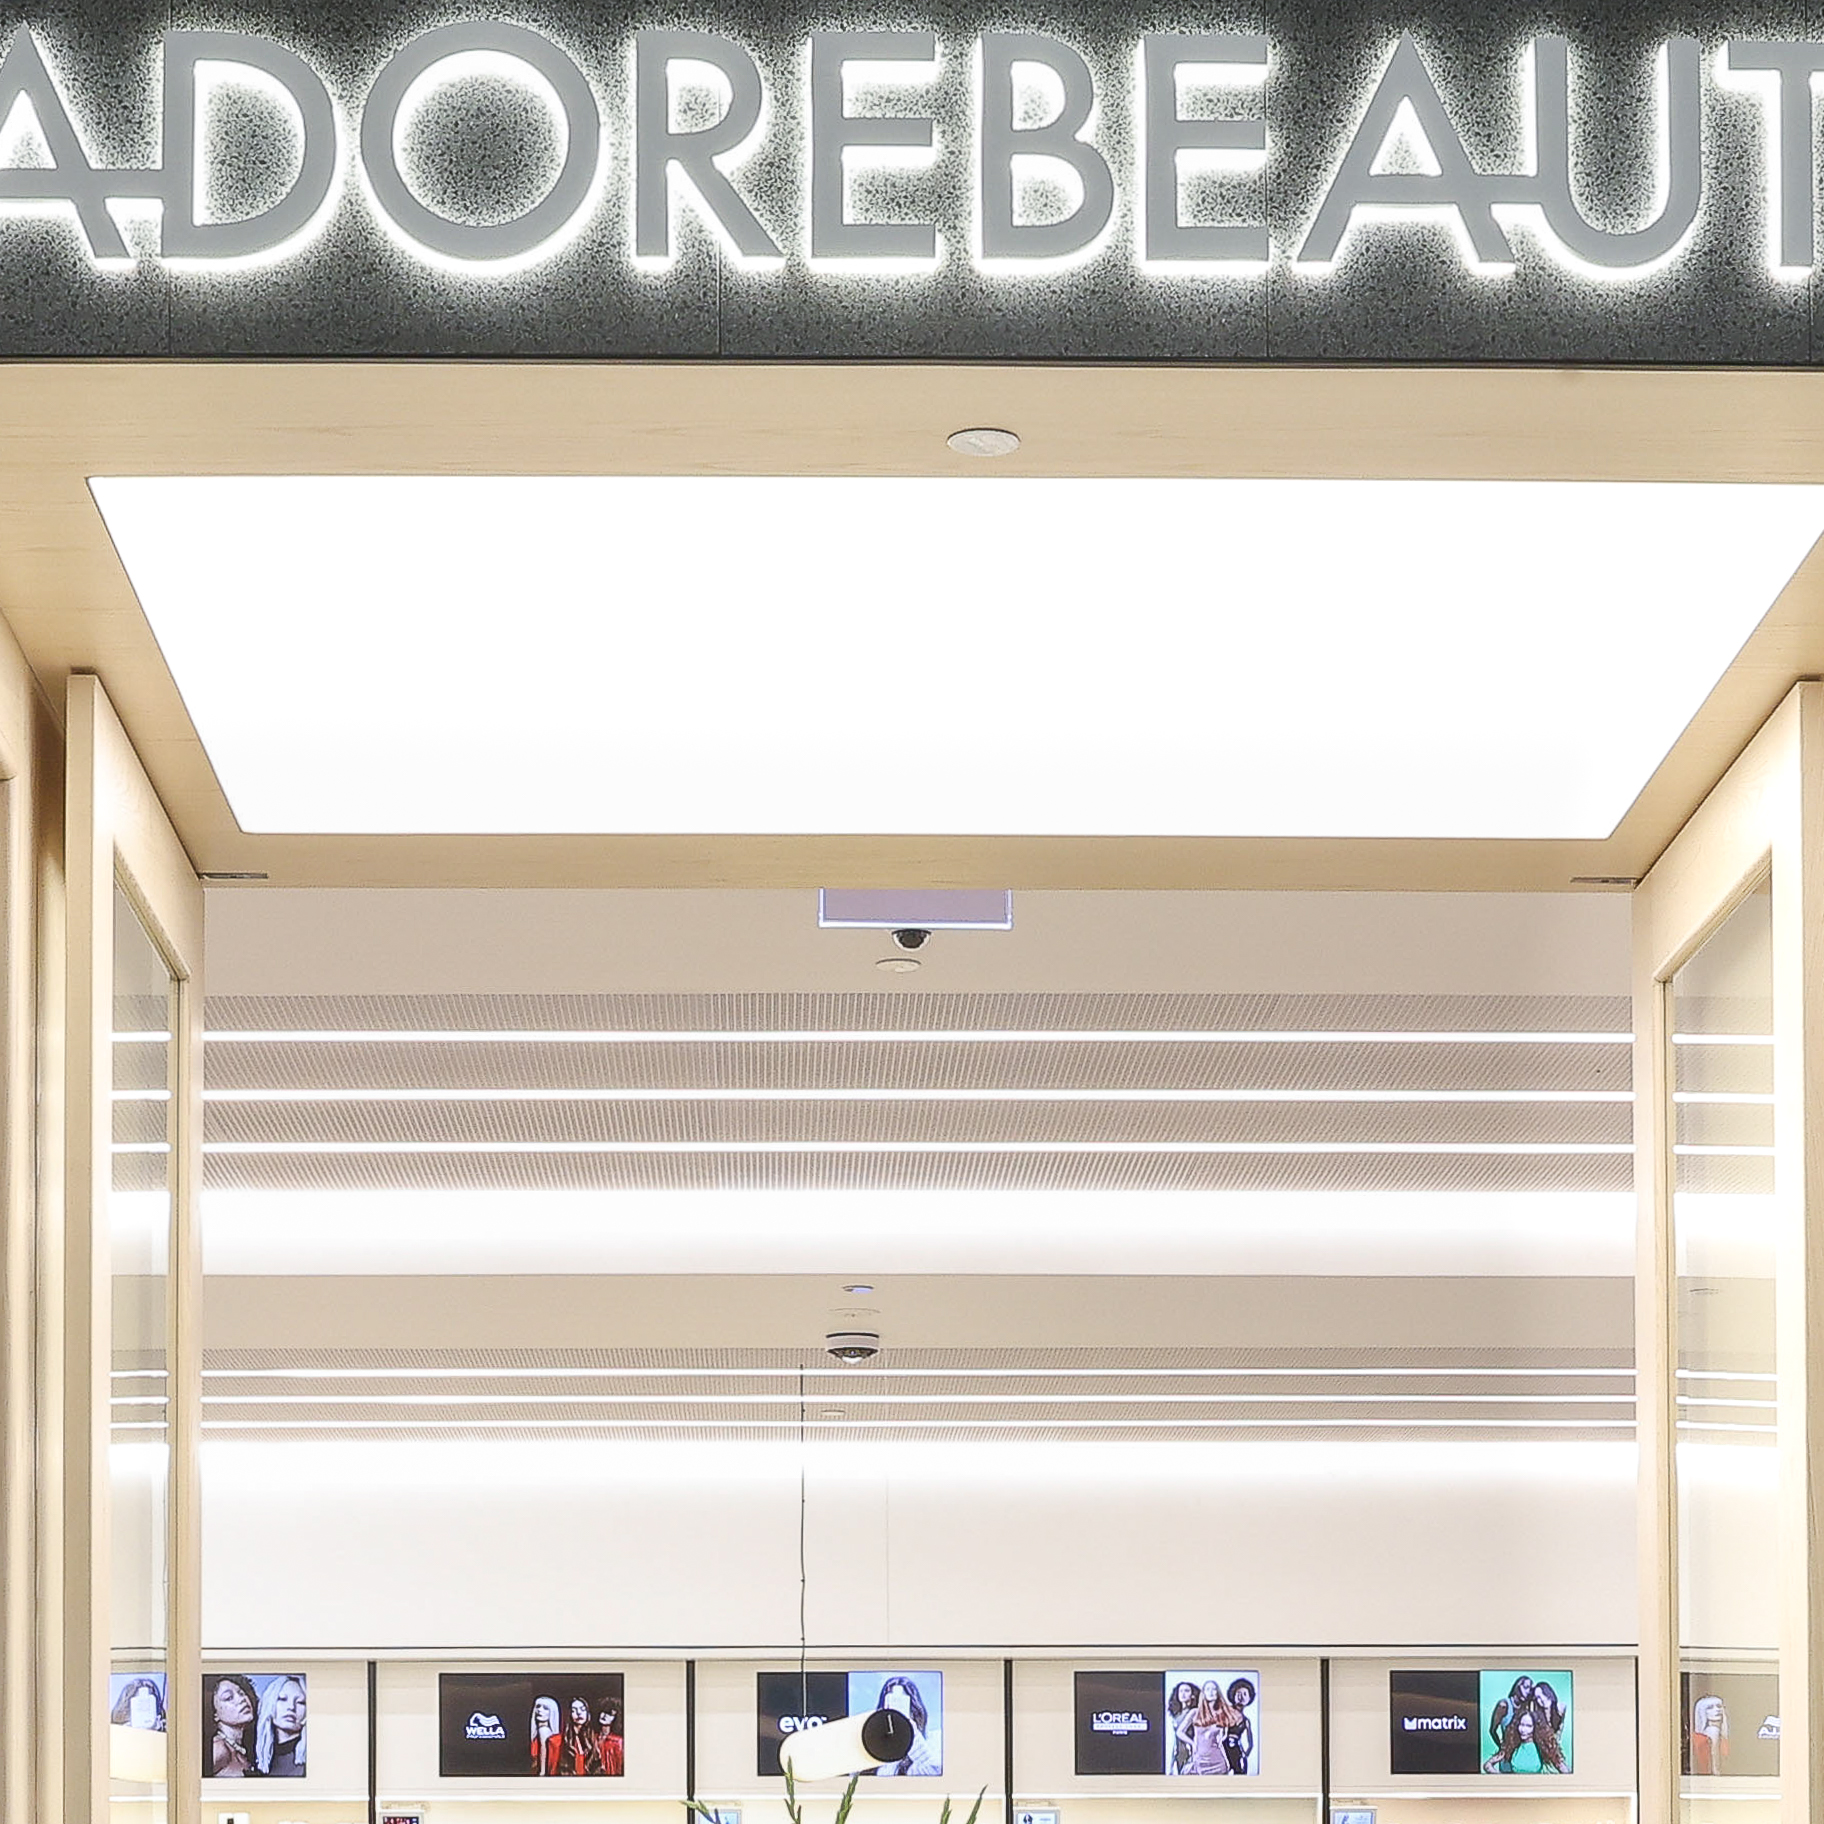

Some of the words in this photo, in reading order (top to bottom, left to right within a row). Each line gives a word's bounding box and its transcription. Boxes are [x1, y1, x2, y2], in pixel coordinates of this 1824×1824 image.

[779, 1716, 824, 1733] evo
[1418, 1715, 1467, 1730] matrix
[466, 1726, 505, 1736] WELLA
